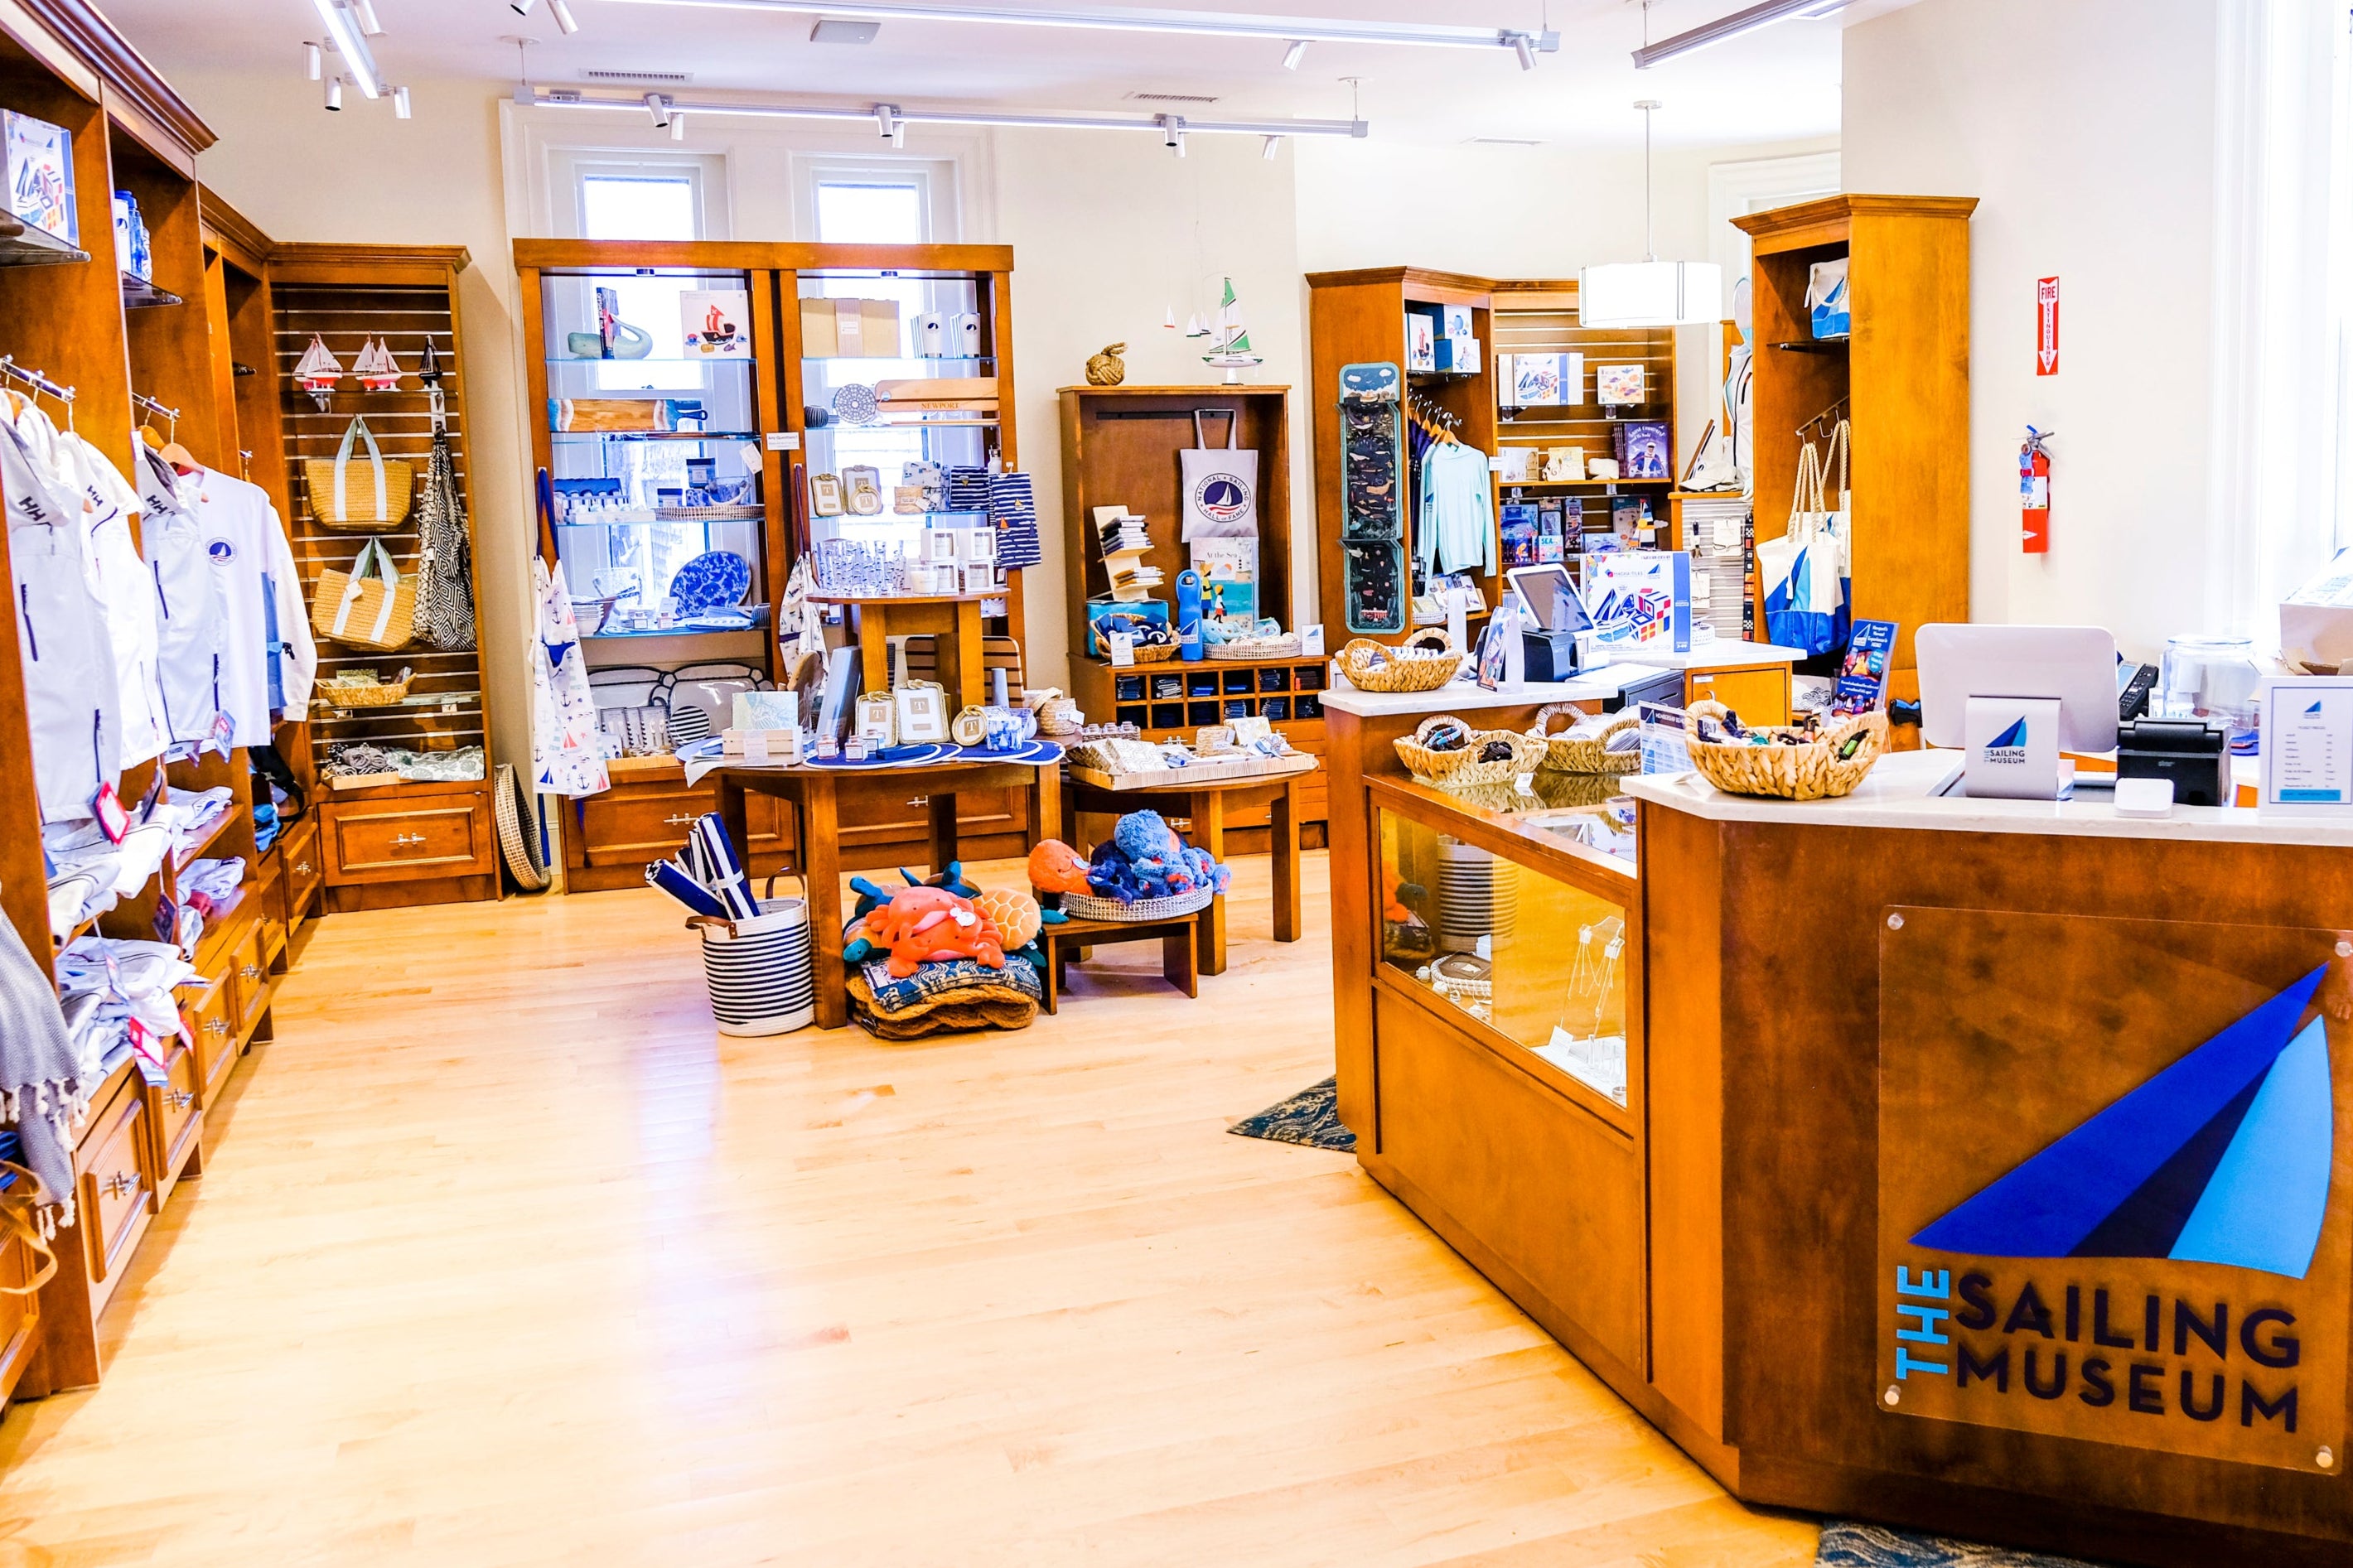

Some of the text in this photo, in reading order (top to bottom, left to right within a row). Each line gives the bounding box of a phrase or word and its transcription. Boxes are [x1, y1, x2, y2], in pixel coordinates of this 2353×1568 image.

[2041, 286, 2056, 300] FIRE
[86, 485, 104, 507] HH
[1197, 475, 1249, 501] NATIONAL SAILING
[18, 495, 46, 522] HH
[146, 495, 167, 515] HH
[1203, 509, 1220, 521] HALL
[1228, 509, 1245, 521] FAME
[1215, 551, 1225, 559] the
[1227, 551, 1238, 559] Sea
[872, 710, 883, 719] T
[915, 702, 925, 711] T
[1896, 1265, 1950, 1379] THE
[1955, 1273, 2300, 1369] SAILING
[1956, 1341, 2298, 1433] MUSEUM
